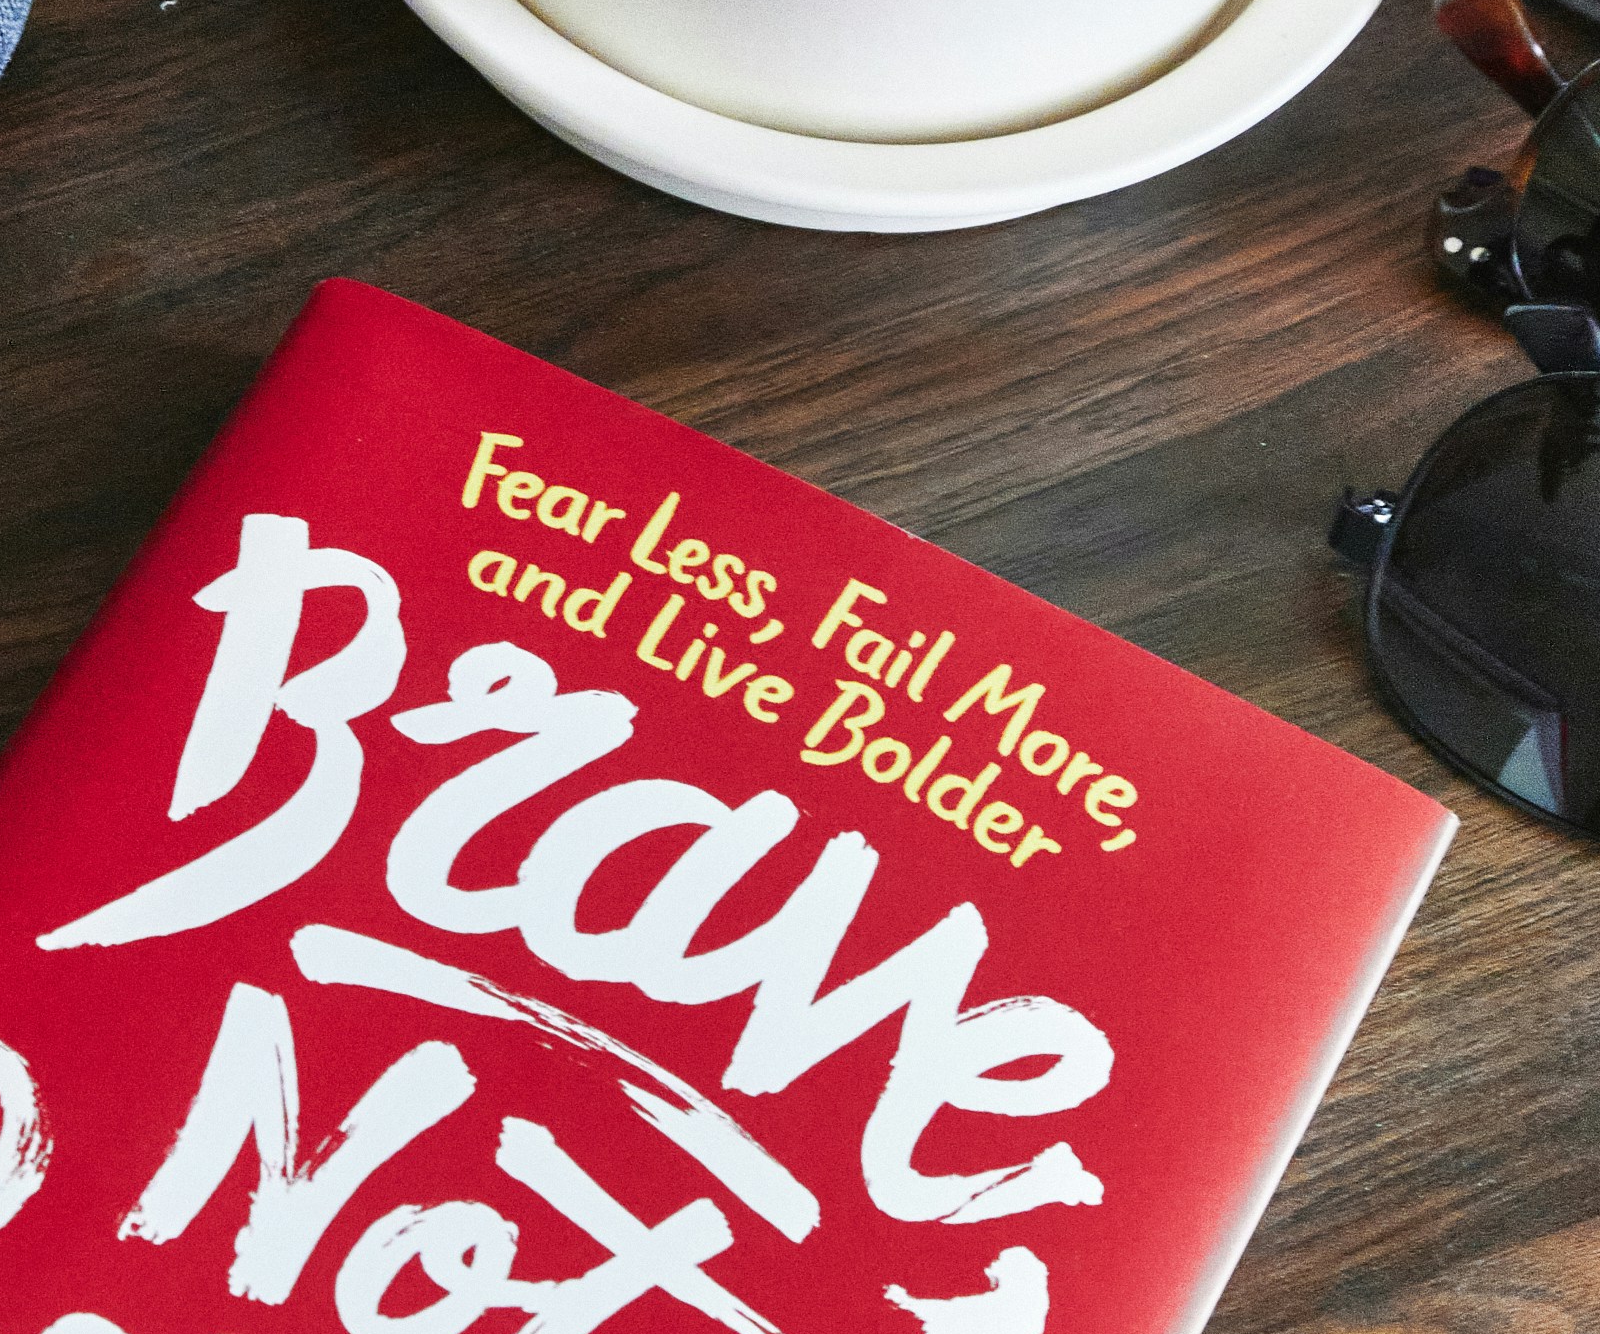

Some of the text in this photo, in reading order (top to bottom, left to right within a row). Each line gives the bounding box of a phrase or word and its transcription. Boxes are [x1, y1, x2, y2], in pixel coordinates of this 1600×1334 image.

[461, 431, 1139, 853] Fear Less, Fail More,
[467, 549, 1062, 868] and Live Bolder
